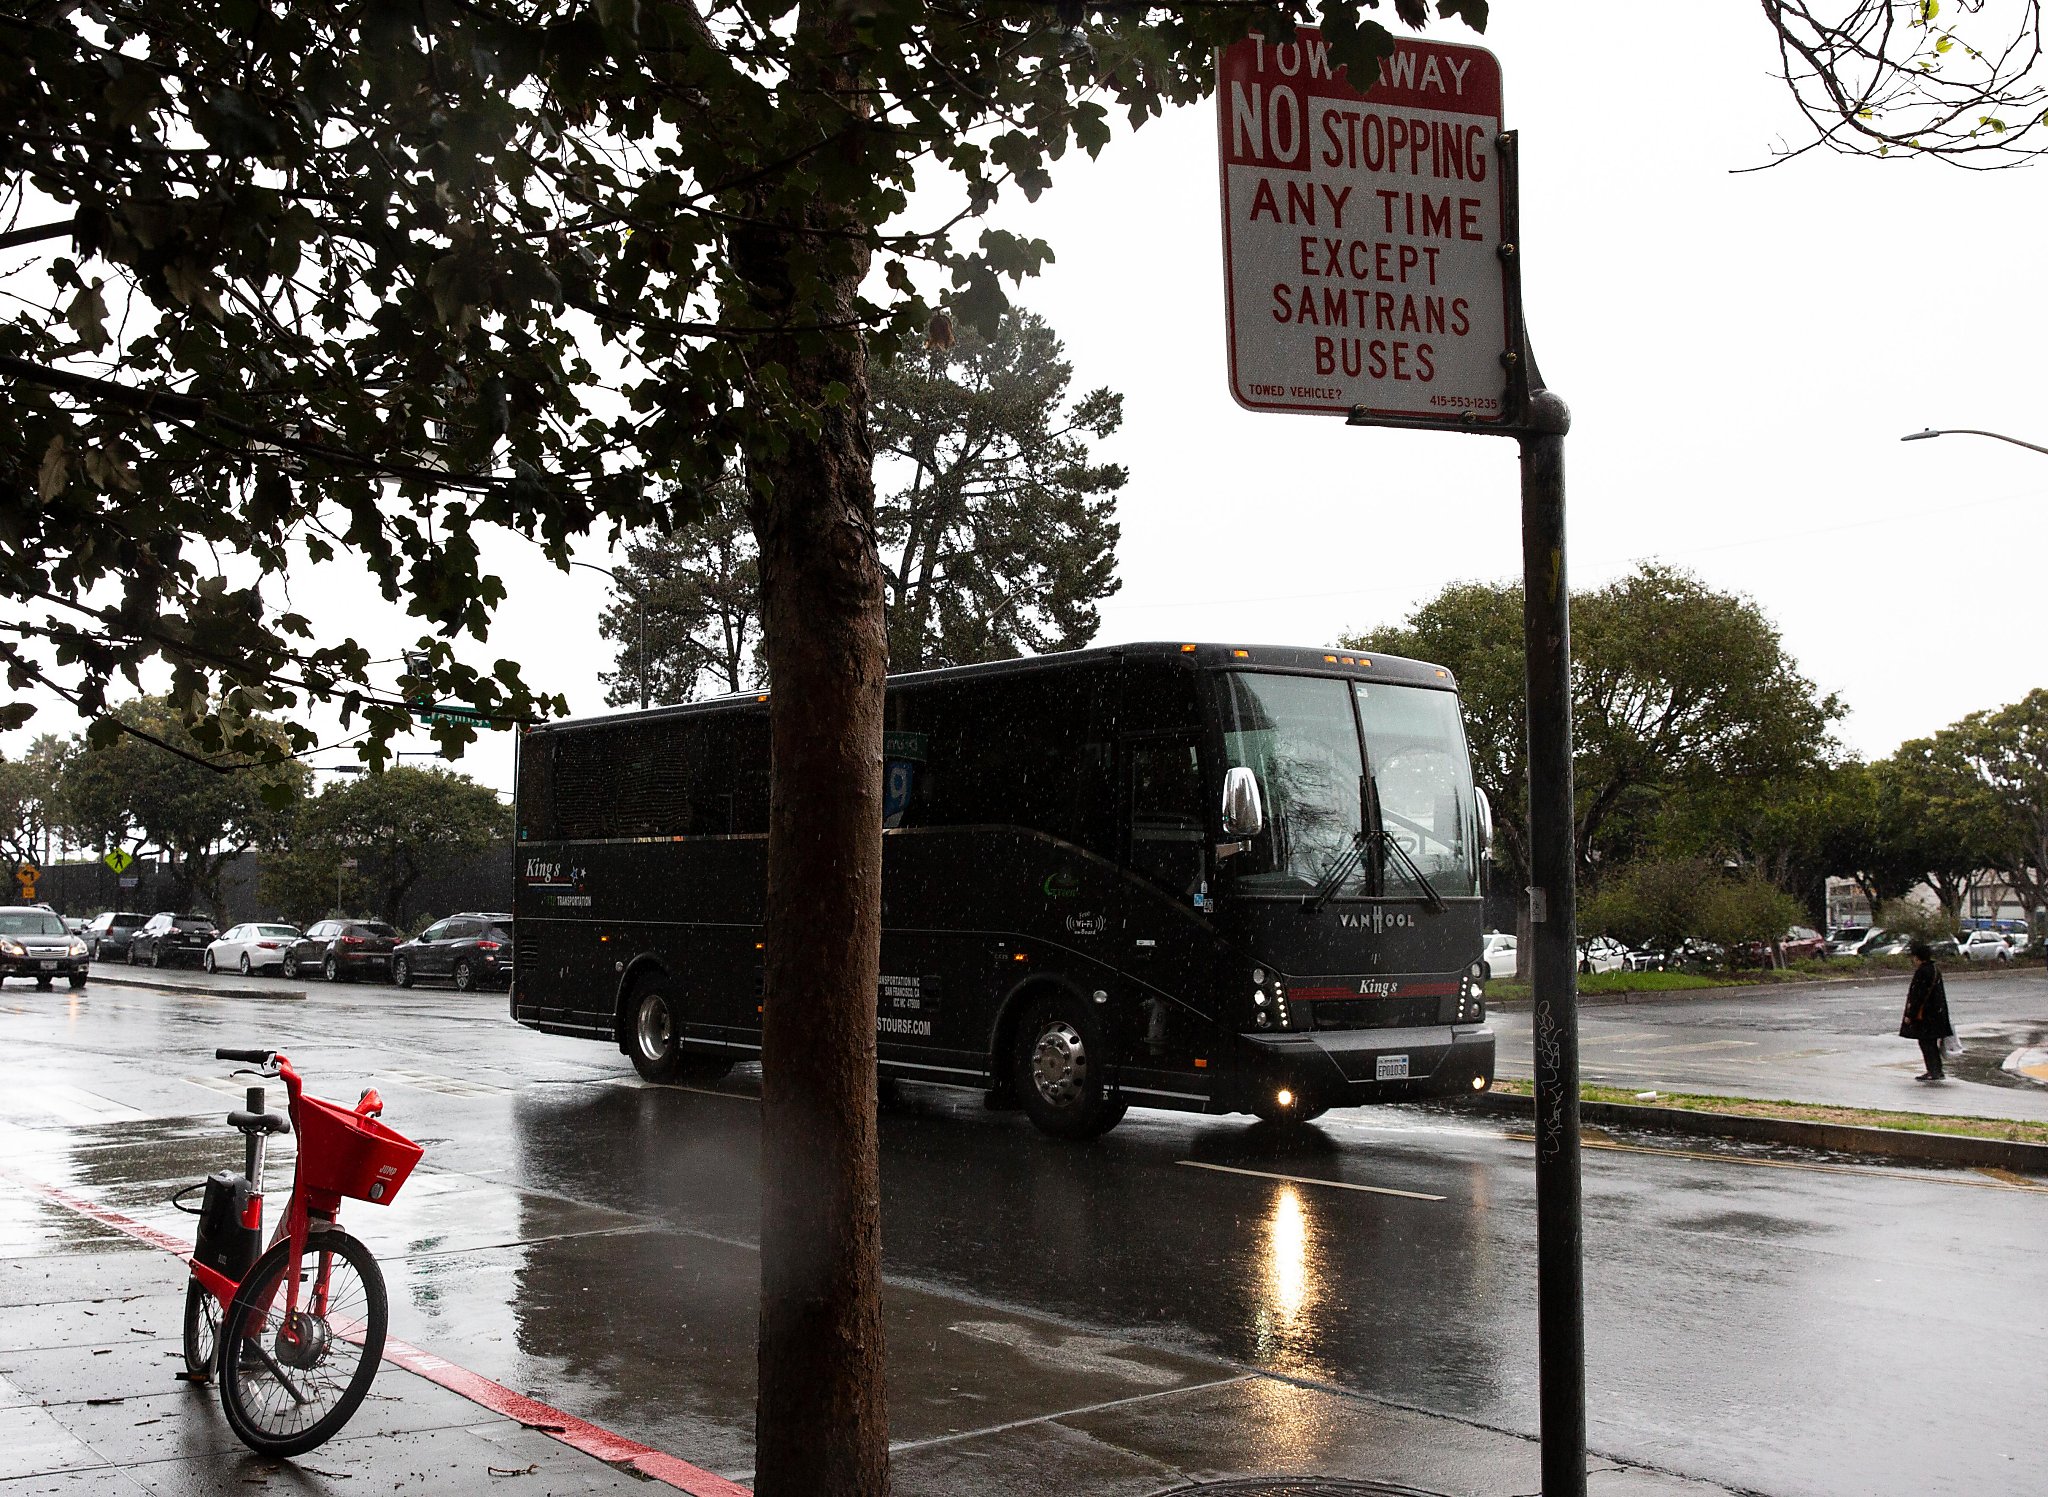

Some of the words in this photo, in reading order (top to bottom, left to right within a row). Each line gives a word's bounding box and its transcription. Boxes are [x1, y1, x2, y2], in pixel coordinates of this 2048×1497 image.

[1248, 33, 1471, 95] TOWWAY
[1231, 81, 1301, 163] NO
[1322, 109, 1486, 182] STOPPING
[1249, 178, 1352, 228] ANY
[1376, 189, 1484, 241] TIME
[1300, 236, 1440, 285] EXCEPT
[1272, 284, 1470, 336] SAMTRANS
[1315, 336, 1435, 382] BUSES
[1249, 384, 1285, 396] TOWED
[1290, 386, 1342, 400] VEHICLE?
[1430, 395, 1497, 409] 415-553-1235
[557, 896, 592, 907] TRANSPORTATION
[878, 975, 912, 987] ANSPORTATION
[912, 977, 920, 987] INC
[884, 986, 893, 996] SAN
[914, 988, 920, 998] CA
[379, 1164, 397, 1176] JUMP
